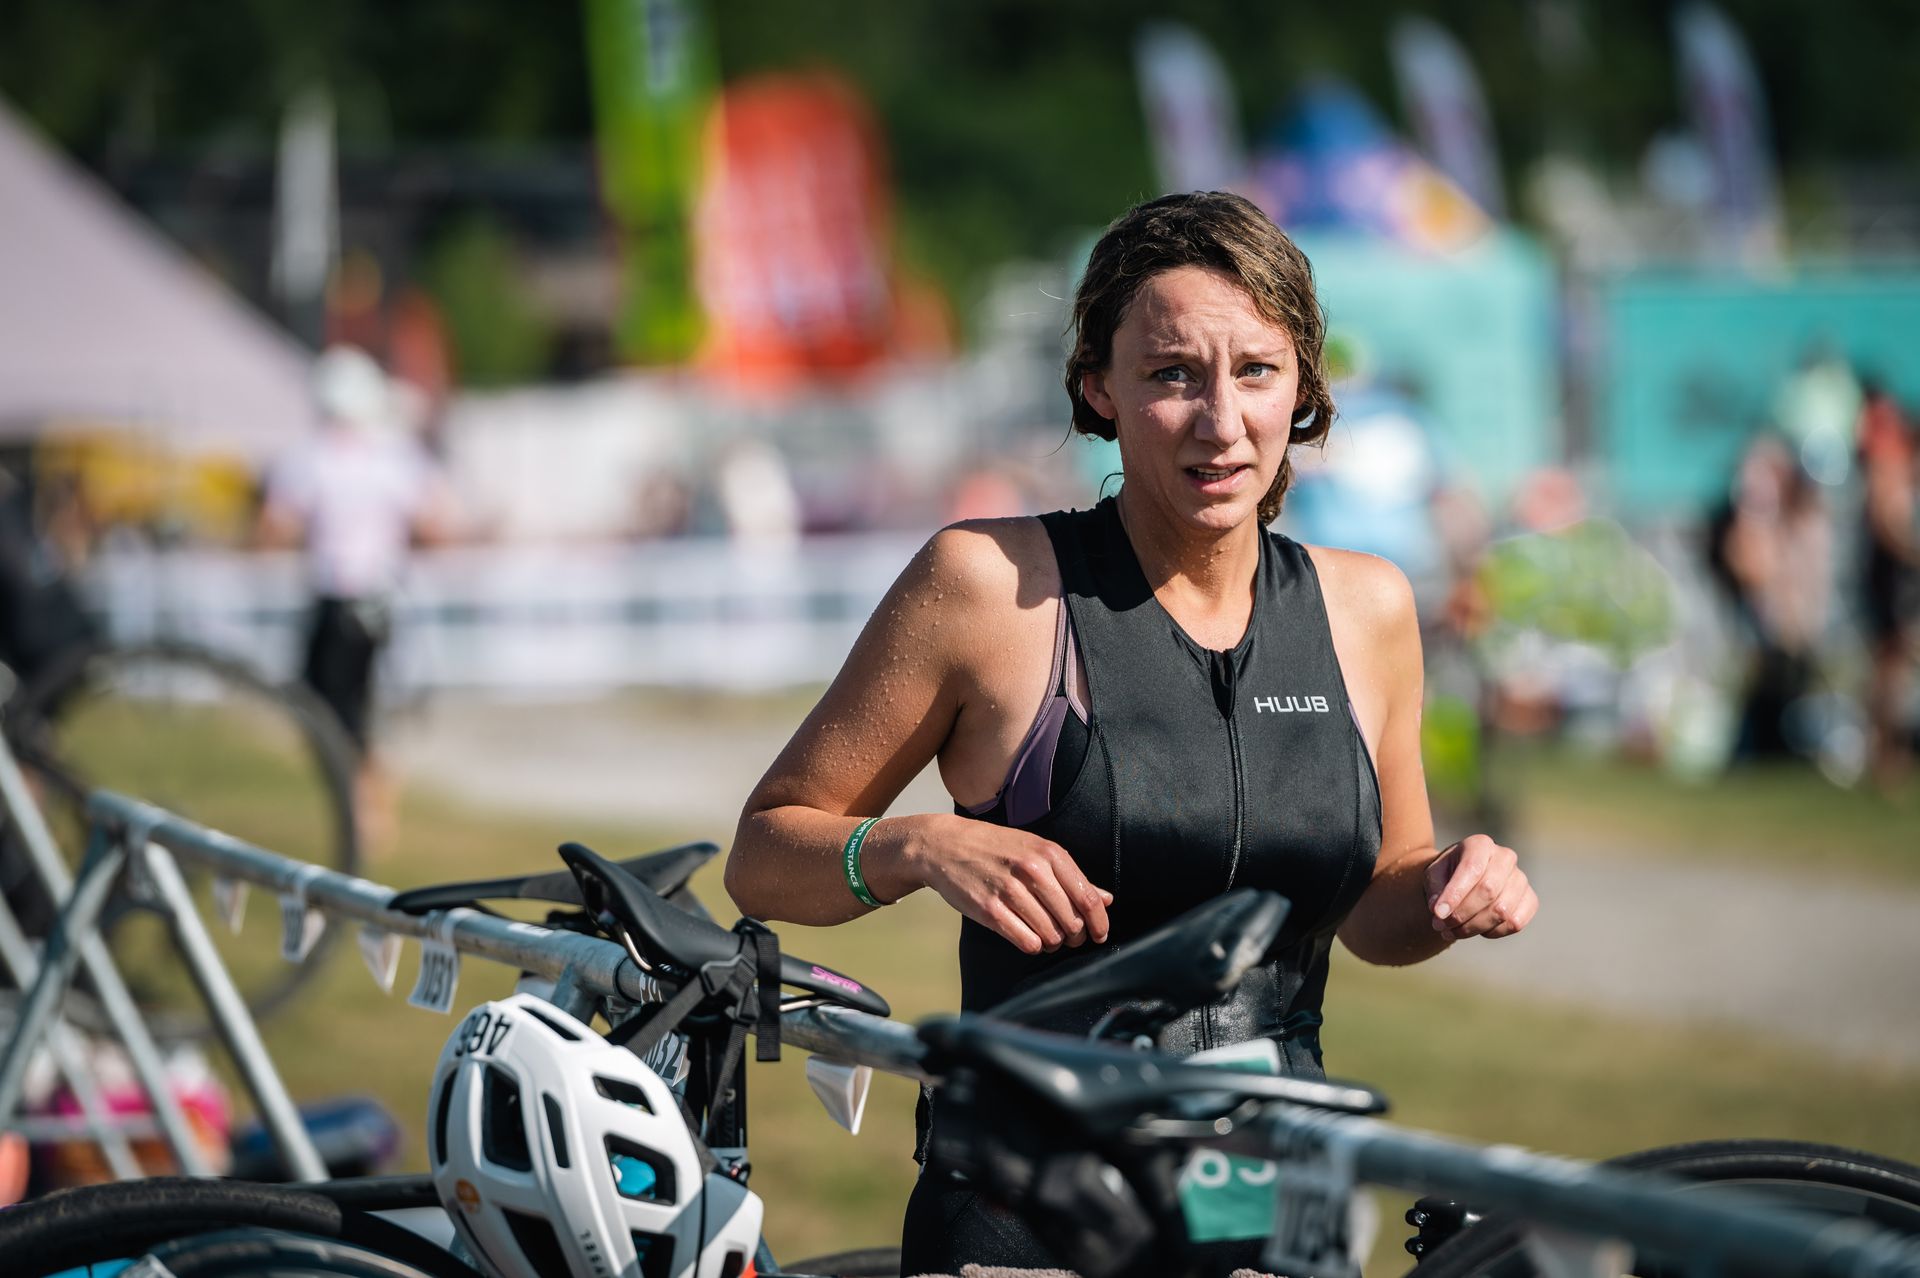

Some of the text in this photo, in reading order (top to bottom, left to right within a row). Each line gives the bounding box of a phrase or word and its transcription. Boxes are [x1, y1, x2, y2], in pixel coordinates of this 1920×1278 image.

[1253, 696, 1330, 714] HUUB
[847, 838, 860, 888] DISTANCE
[643, 1028, 679, 1080] 032
